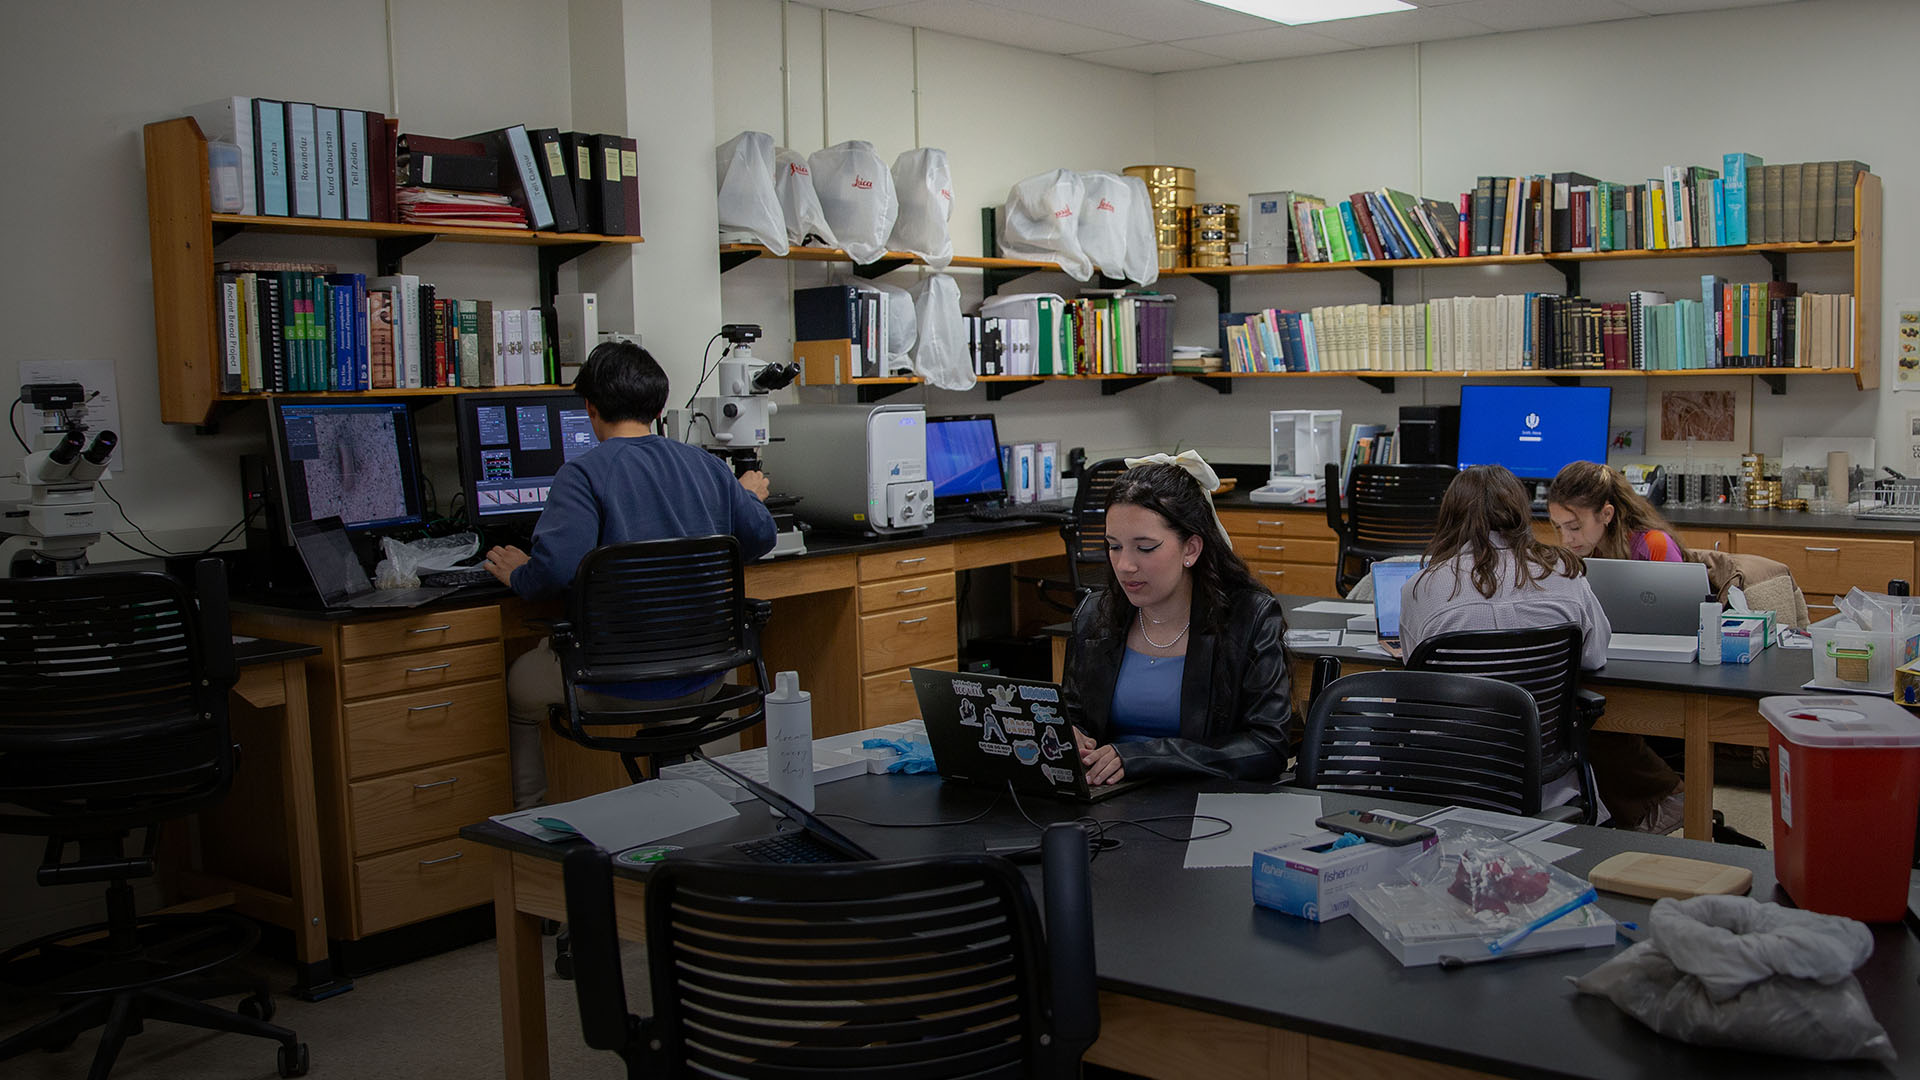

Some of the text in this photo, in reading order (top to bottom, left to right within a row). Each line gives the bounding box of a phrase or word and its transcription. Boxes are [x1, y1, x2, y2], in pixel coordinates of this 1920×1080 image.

[270, 142, 279, 177] Surezha
[300, 137, 309, 181] Rowanduz
[325, 131, 335, 196] Kurd Qaburstan
[349, 142, 359, 186] Tell Zeidan
[851, 175, 873, 190] Leica
[227, 284, 237, 367] Ancient Bread Project
[1323, 862, 1369, 884] fisherbrand
